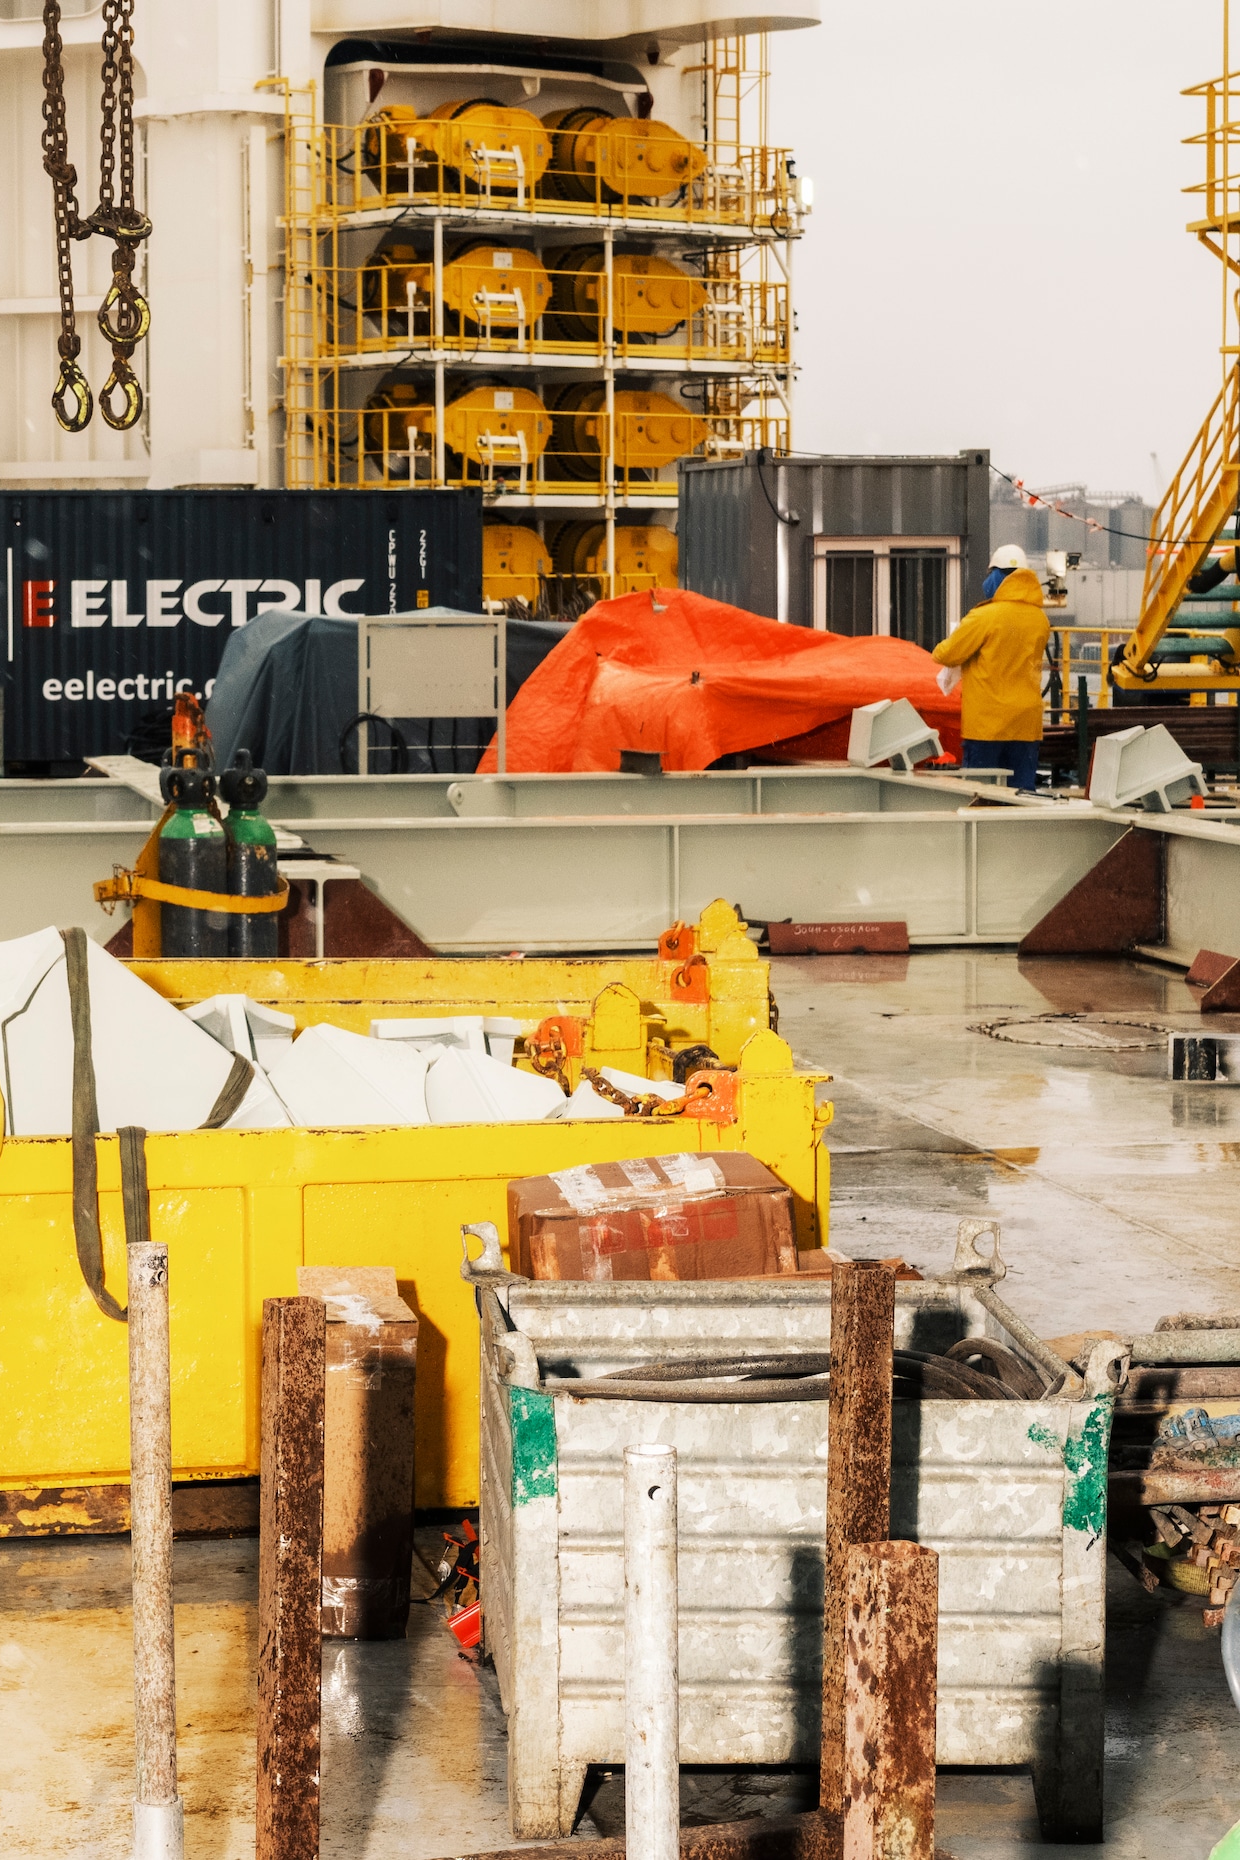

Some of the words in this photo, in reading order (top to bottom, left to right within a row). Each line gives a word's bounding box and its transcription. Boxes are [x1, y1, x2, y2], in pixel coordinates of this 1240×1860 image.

[388, 529, 397, 579] CPWU
[419, 529, 427, 579] 22G1
[22, 579, 57, 628] E
[70, 578, 366, 628] ELECTRIC
